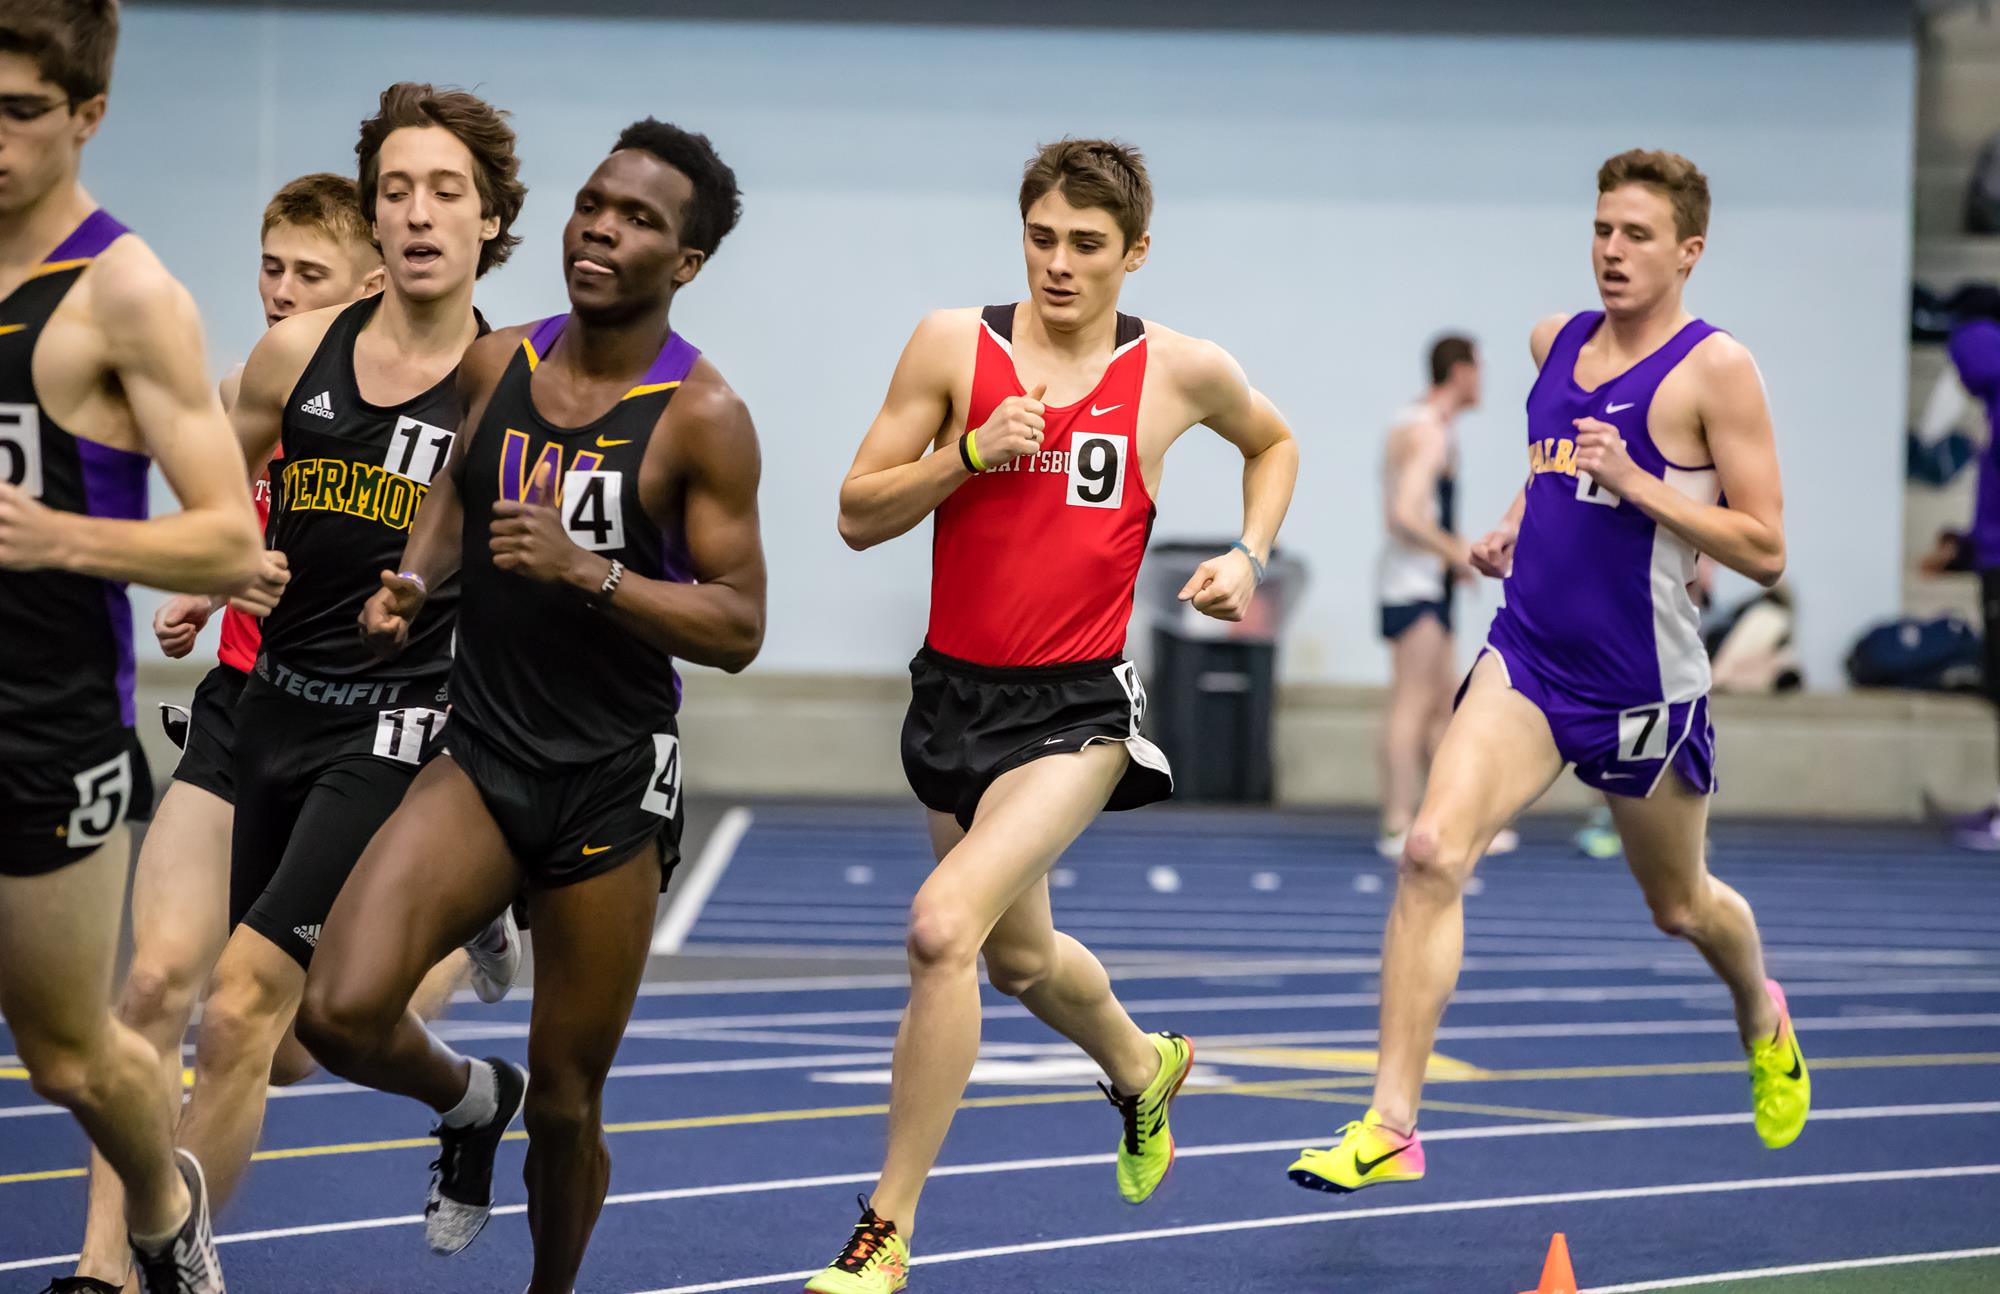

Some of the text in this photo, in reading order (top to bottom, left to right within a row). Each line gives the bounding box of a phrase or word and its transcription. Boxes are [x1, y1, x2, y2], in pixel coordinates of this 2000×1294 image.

[301, 403, 336, 420] adidas
[396, 423, 454, 486] 11
[1076, 437, 1119, 503] 9
[569, 476, 614, 545] 4
[273, 663, 411, 706] TECHFIT
[384, 709, 436, 764] 11
[1625, 708, 1661, 757] 7
[79, 767, 123, 838] 5
[653, 742, 677, 812] 4
